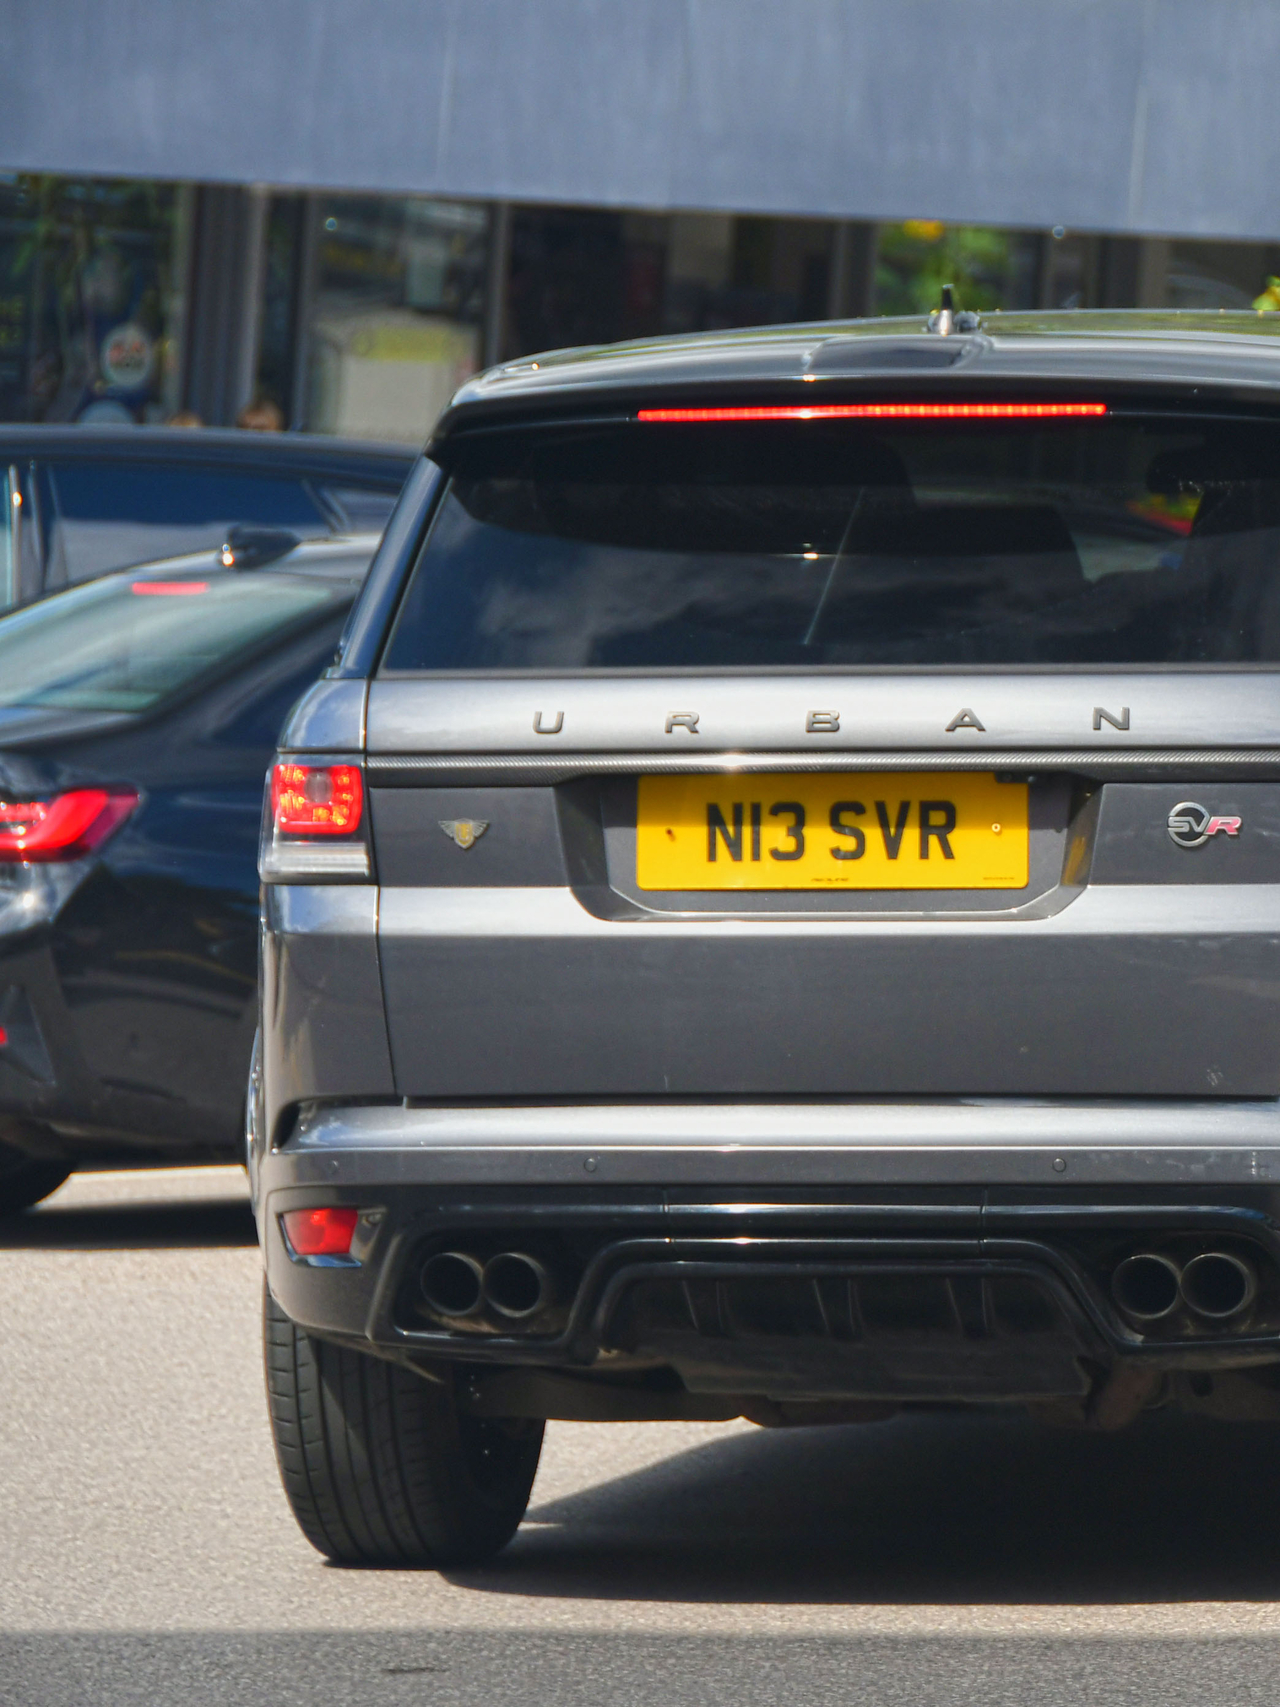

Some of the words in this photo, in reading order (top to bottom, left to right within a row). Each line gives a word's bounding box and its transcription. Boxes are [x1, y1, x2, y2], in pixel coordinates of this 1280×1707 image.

[532, 706, 1131, 734] URBAN
[706, 801, 806, 862] N13
[829, 801, 957, 861] SVR
[1167, 807, 1242, 841] SVR
